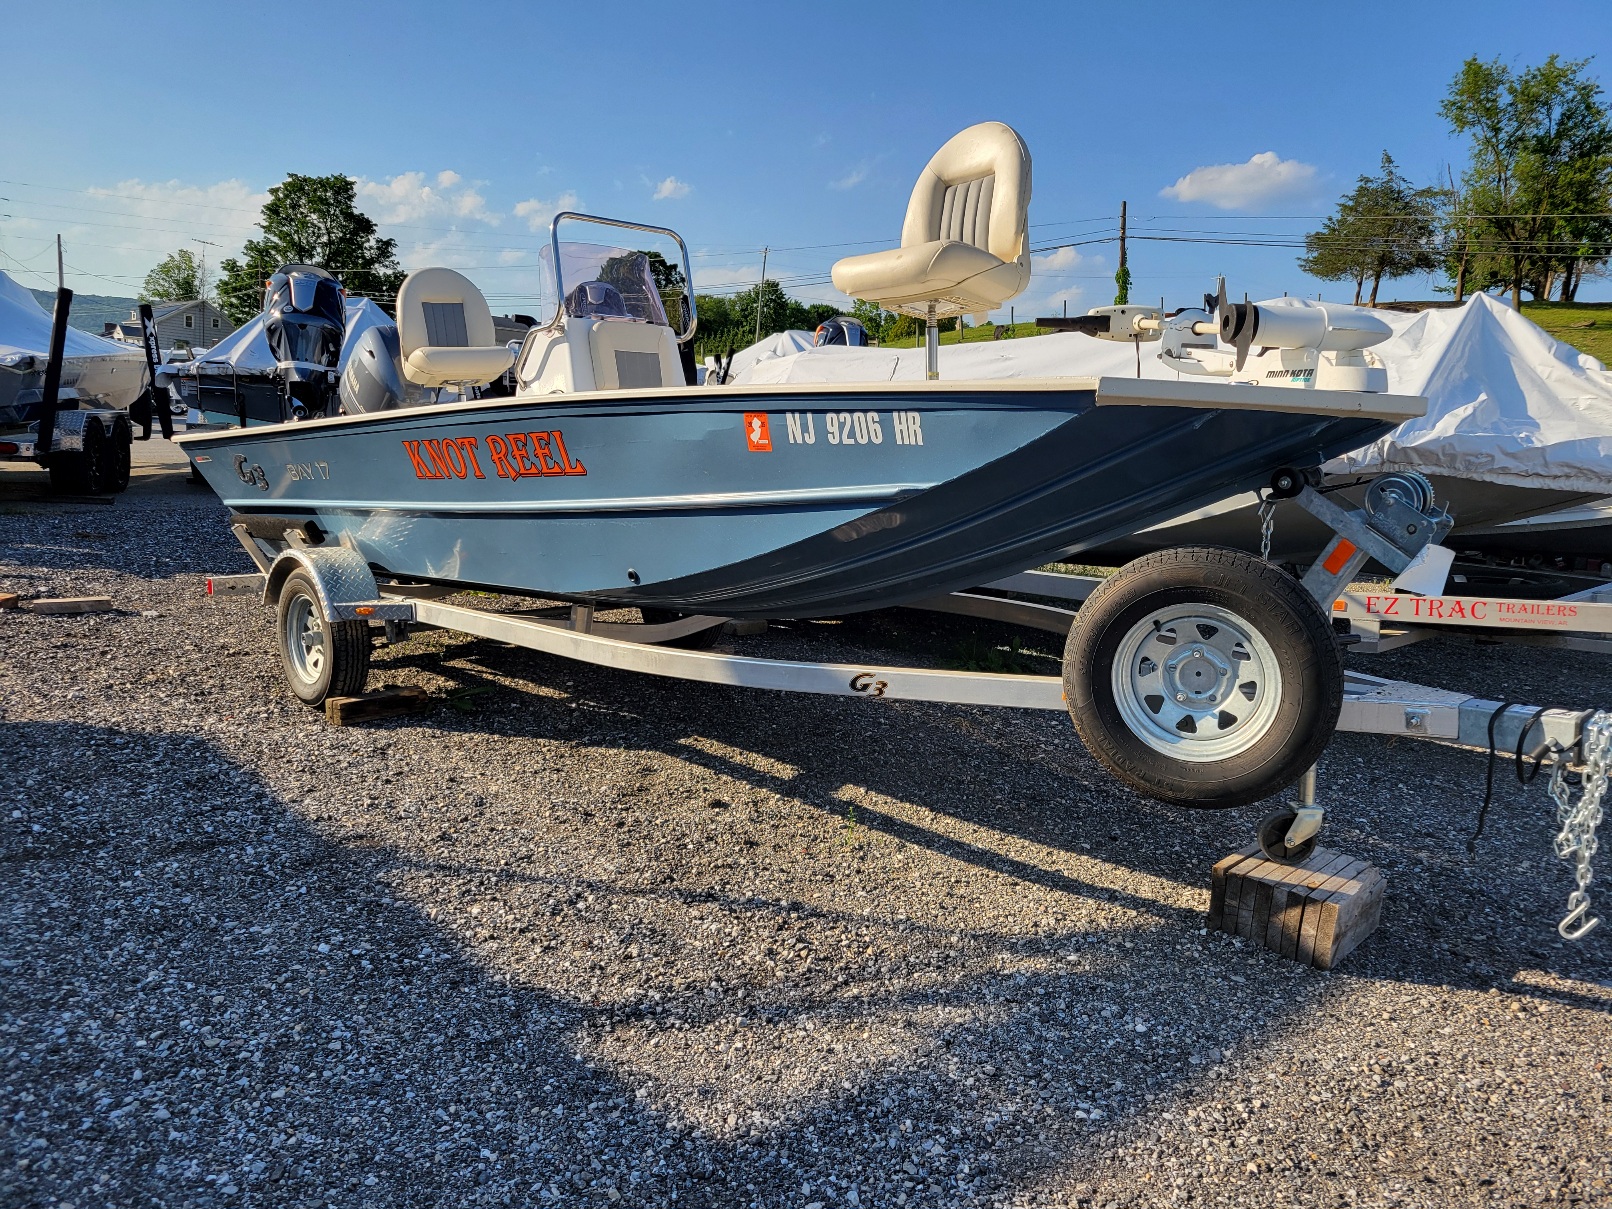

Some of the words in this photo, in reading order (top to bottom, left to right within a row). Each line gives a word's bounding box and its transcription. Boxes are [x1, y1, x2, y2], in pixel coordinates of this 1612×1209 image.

[1289, 368, 1315, 378] KOTA
[785, 411, 816, 444] NJ
[825, 411, 883, 445] 9206
[892, 410, 924, 446] HR
[402, 436, 486, 480] KNOT
[485, 430, 588, 482] REEL
[286, 462, 315, 481] BAY
[315, 461, 330, 480] 17
[1365, 596, 1399, 615] EZ
[1410, 598, 1487, 620] TRAC
[1496, 602, 1578, 617] TRAILERS
[849, 672, 888, 698] G3
